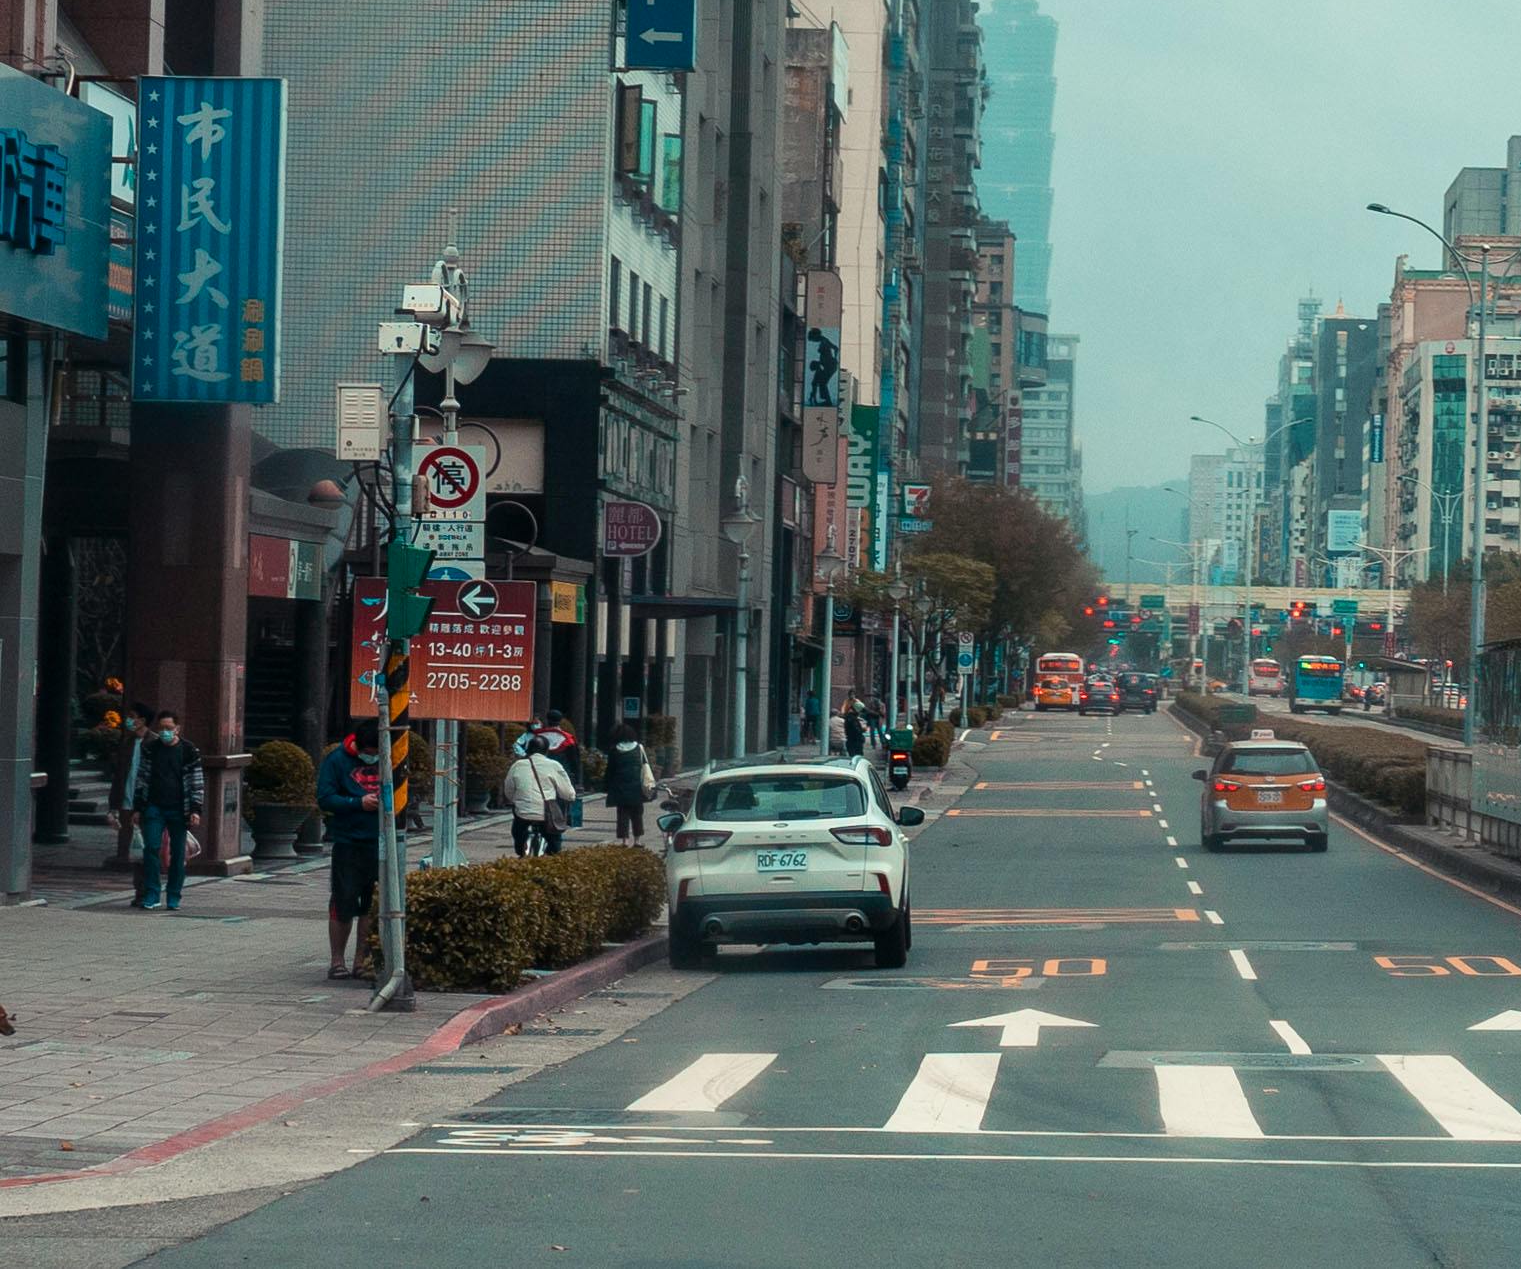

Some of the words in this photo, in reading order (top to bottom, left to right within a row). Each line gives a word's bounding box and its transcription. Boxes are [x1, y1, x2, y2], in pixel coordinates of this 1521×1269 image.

[171, 101, 233, 383] 市民大道
[431, 461, 466, 495] 停
[607, 506, 646, 525] 麗都
[607, 525, 655, 541] HOTEL
[426, 672, 522, 691] 2705-2288
[757, 853, 807, 868] RDF-6762
[970, 959, 1107, 979] 50
